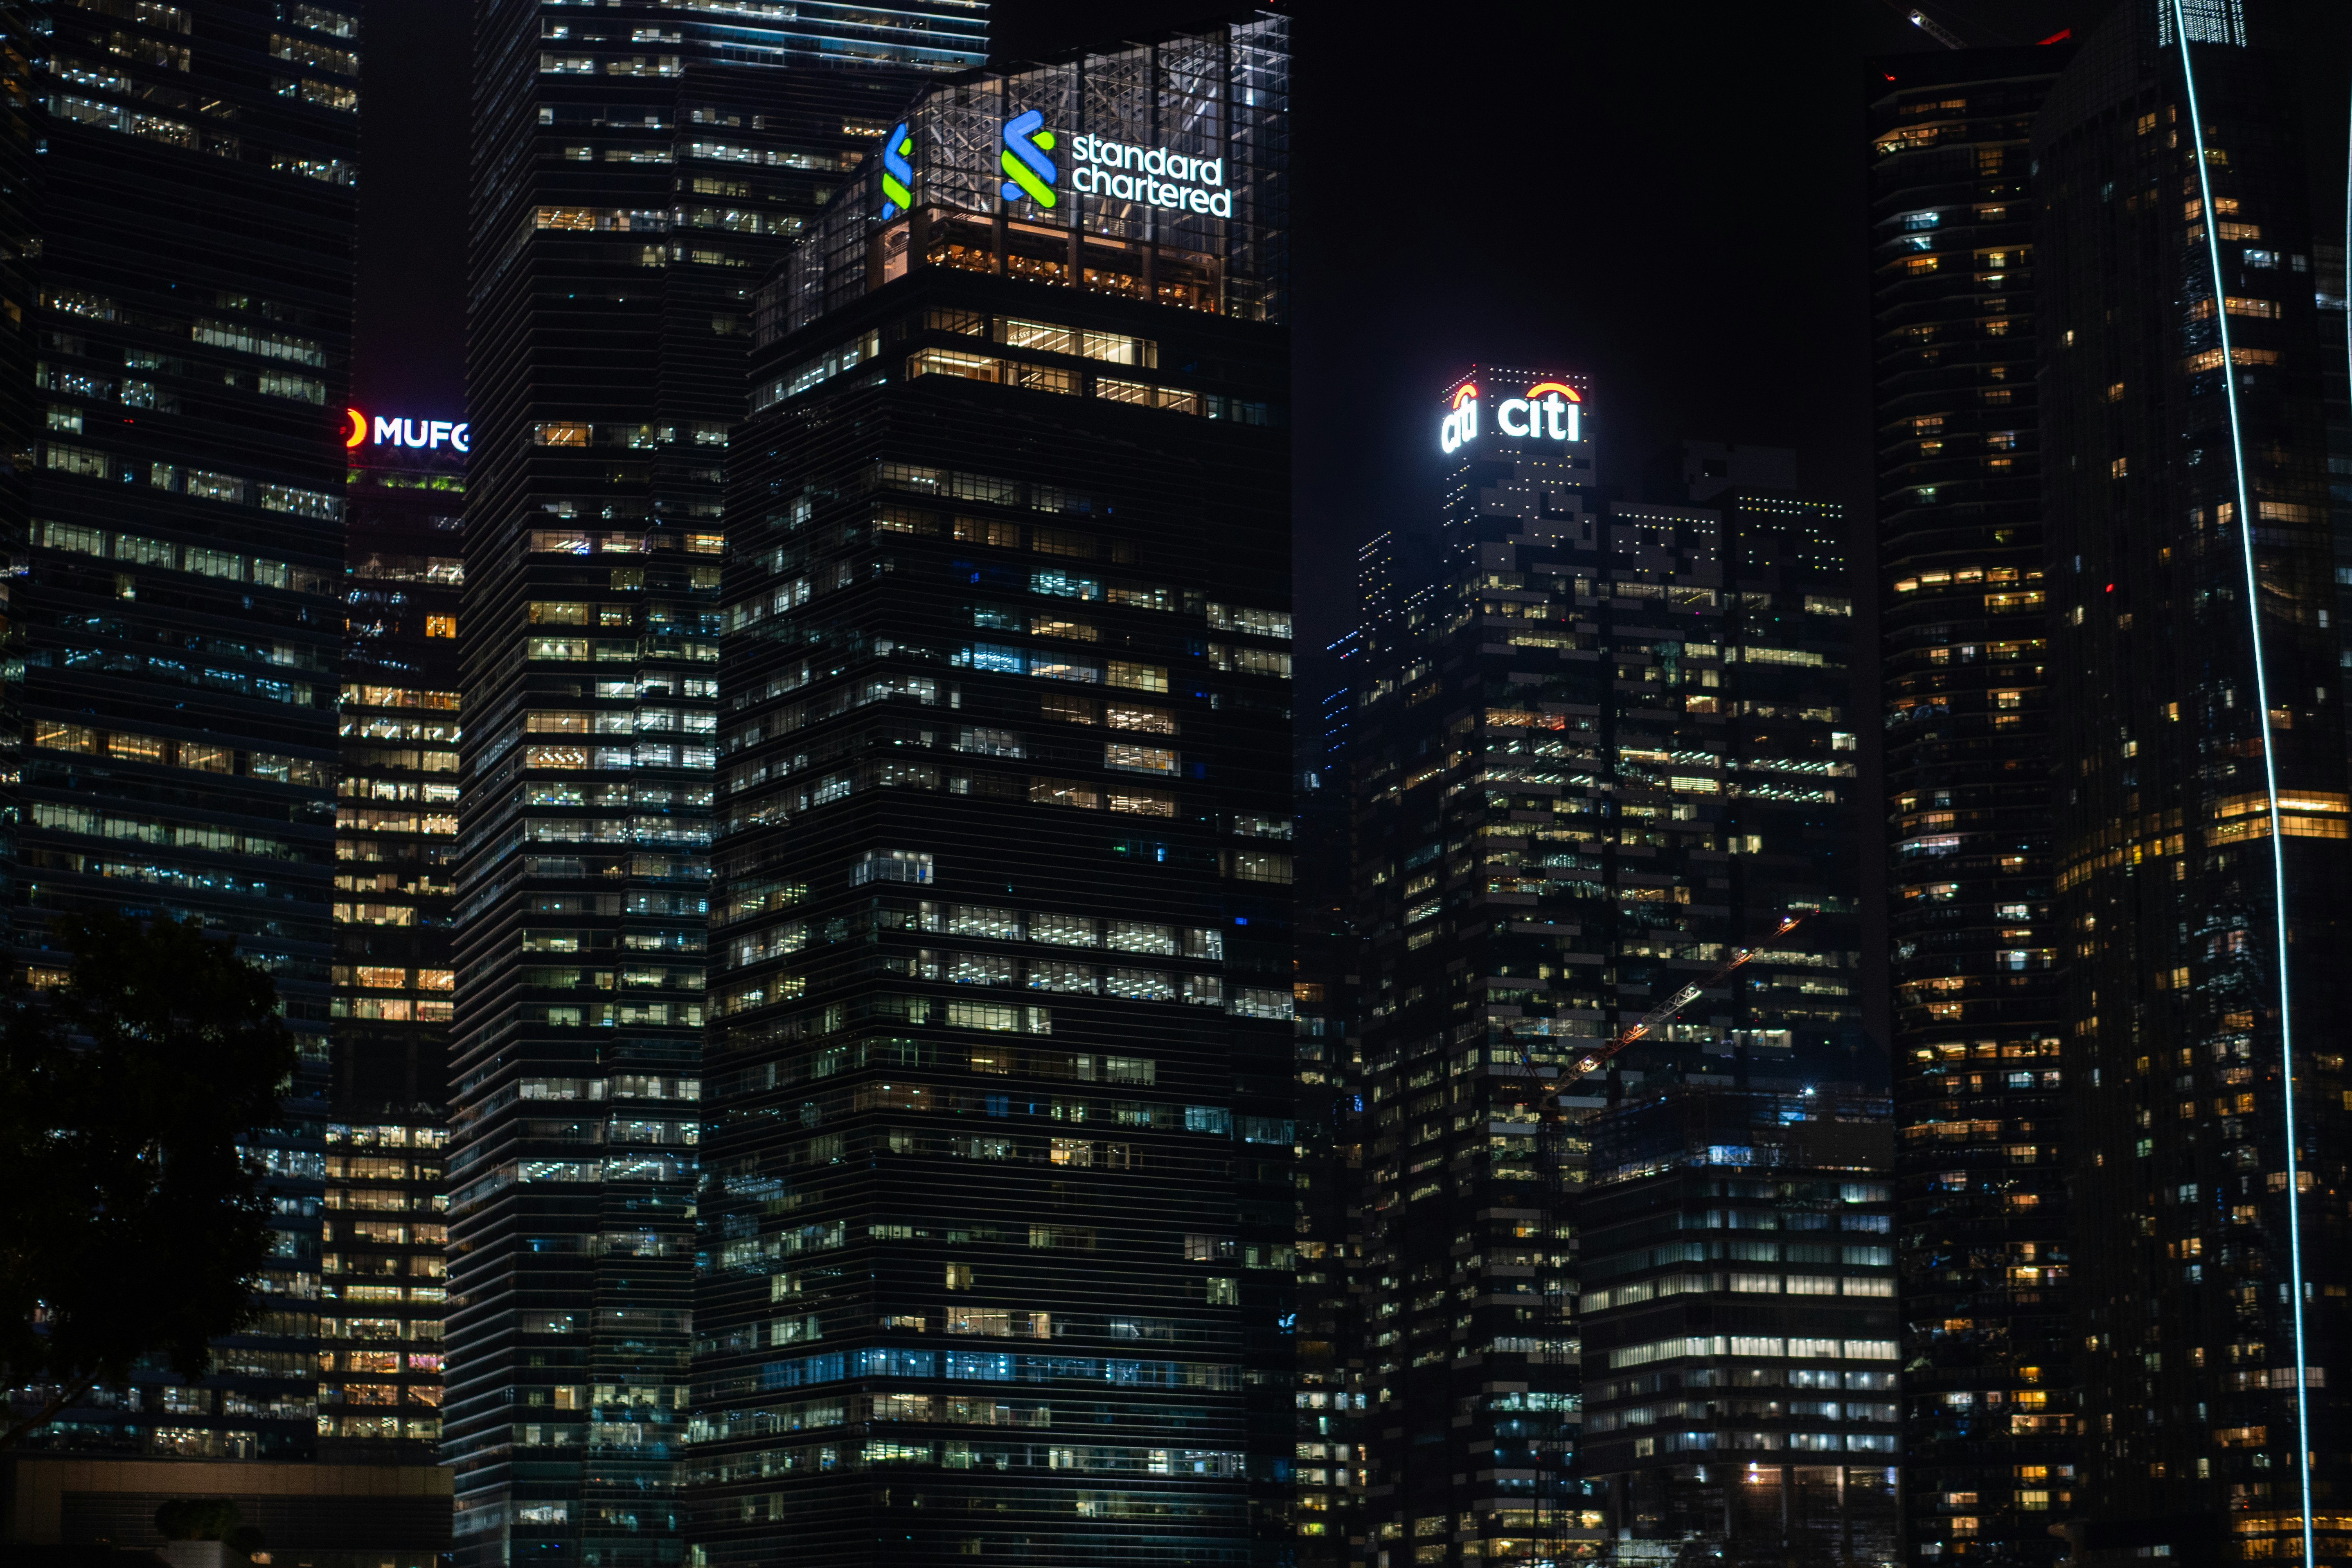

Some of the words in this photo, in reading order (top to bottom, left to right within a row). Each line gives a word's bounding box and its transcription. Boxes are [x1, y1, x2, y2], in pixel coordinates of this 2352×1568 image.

[1072, 133, 1223, 187] standard
[1072, 164, 1232, 218] chartered
[1441, 395, 1478, 453] citi
[1498, 392, 1579, 442] citi
